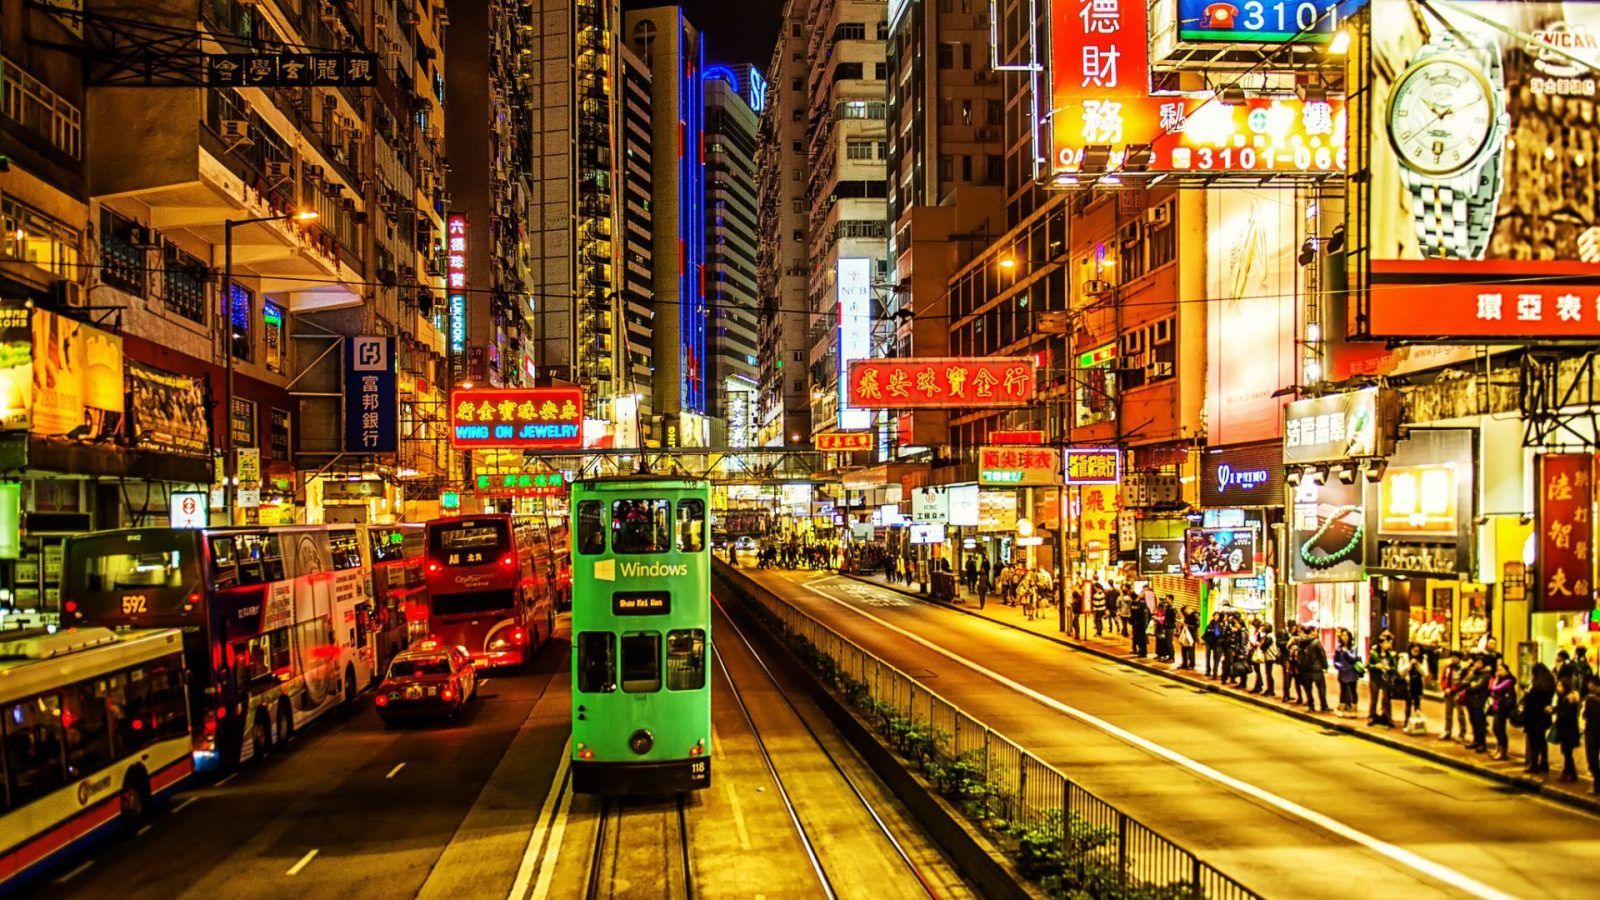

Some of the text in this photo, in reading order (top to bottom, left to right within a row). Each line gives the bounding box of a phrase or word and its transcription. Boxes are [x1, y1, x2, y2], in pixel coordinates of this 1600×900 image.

[1243, 1, 1337, 31] 3101
[841, 286, 867, 295] NCB
[1477, 293, 1600, 321] 環亞表
[856, 366, 1030, 399] 飛安珠寶金行
[362, 375, 379, 447] 富邦銀行
[455, 424, 579, 439] WING ON JEWELRY
[1548, 472, 1573, 596] 陸智夫
[619, 560, 688, 578] Windows
[122, 595, 147, 614] 592
[691, 762, 705, 773] 118
